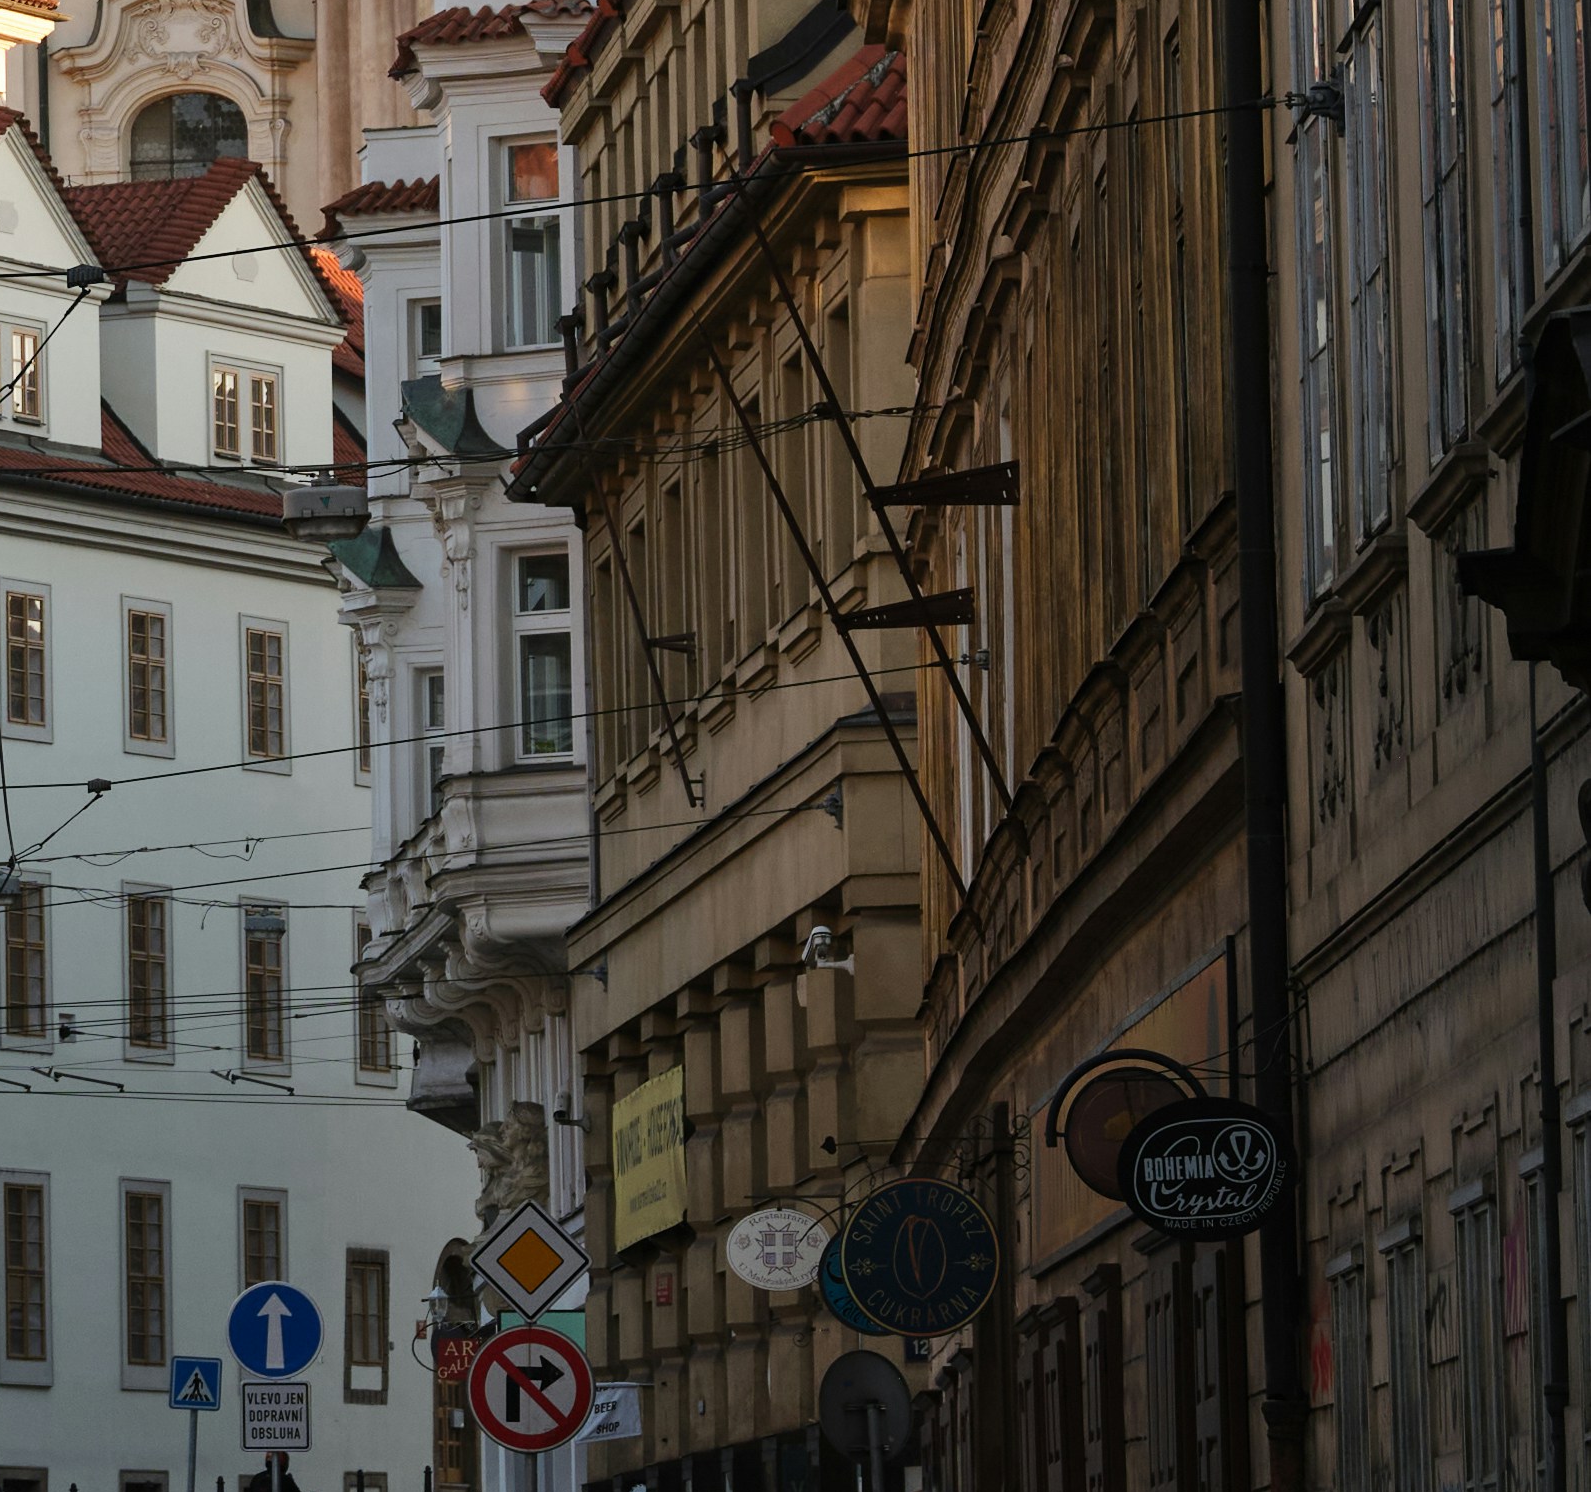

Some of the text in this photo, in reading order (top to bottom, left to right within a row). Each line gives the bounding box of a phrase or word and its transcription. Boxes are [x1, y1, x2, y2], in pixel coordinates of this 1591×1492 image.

[1143, 1154, 1215, 1182] BOHEMIA
[1150, 1136, 1258, 1216] Crystal
[1163, 1160, 1288, 1229] MADE IN CZECH REPUBLIC
[749, 1212, 809, 1227] Restaurant
[852, 1186, 987, 1245] SAINT TROPEZ
[913, 1339, 929, 1355] 12
[437, 1356, 471, 1379] GALL
[247, 1392, 304, 1405] VLEVO JEN
[249, 1407, 303, 1422] DOPRAVNÍ
[594, 1400, 618, 1414] BEER
[251, 1427, 301, 1439] OBSLUHA
[596, 1421, 620, 1435] SHOP
